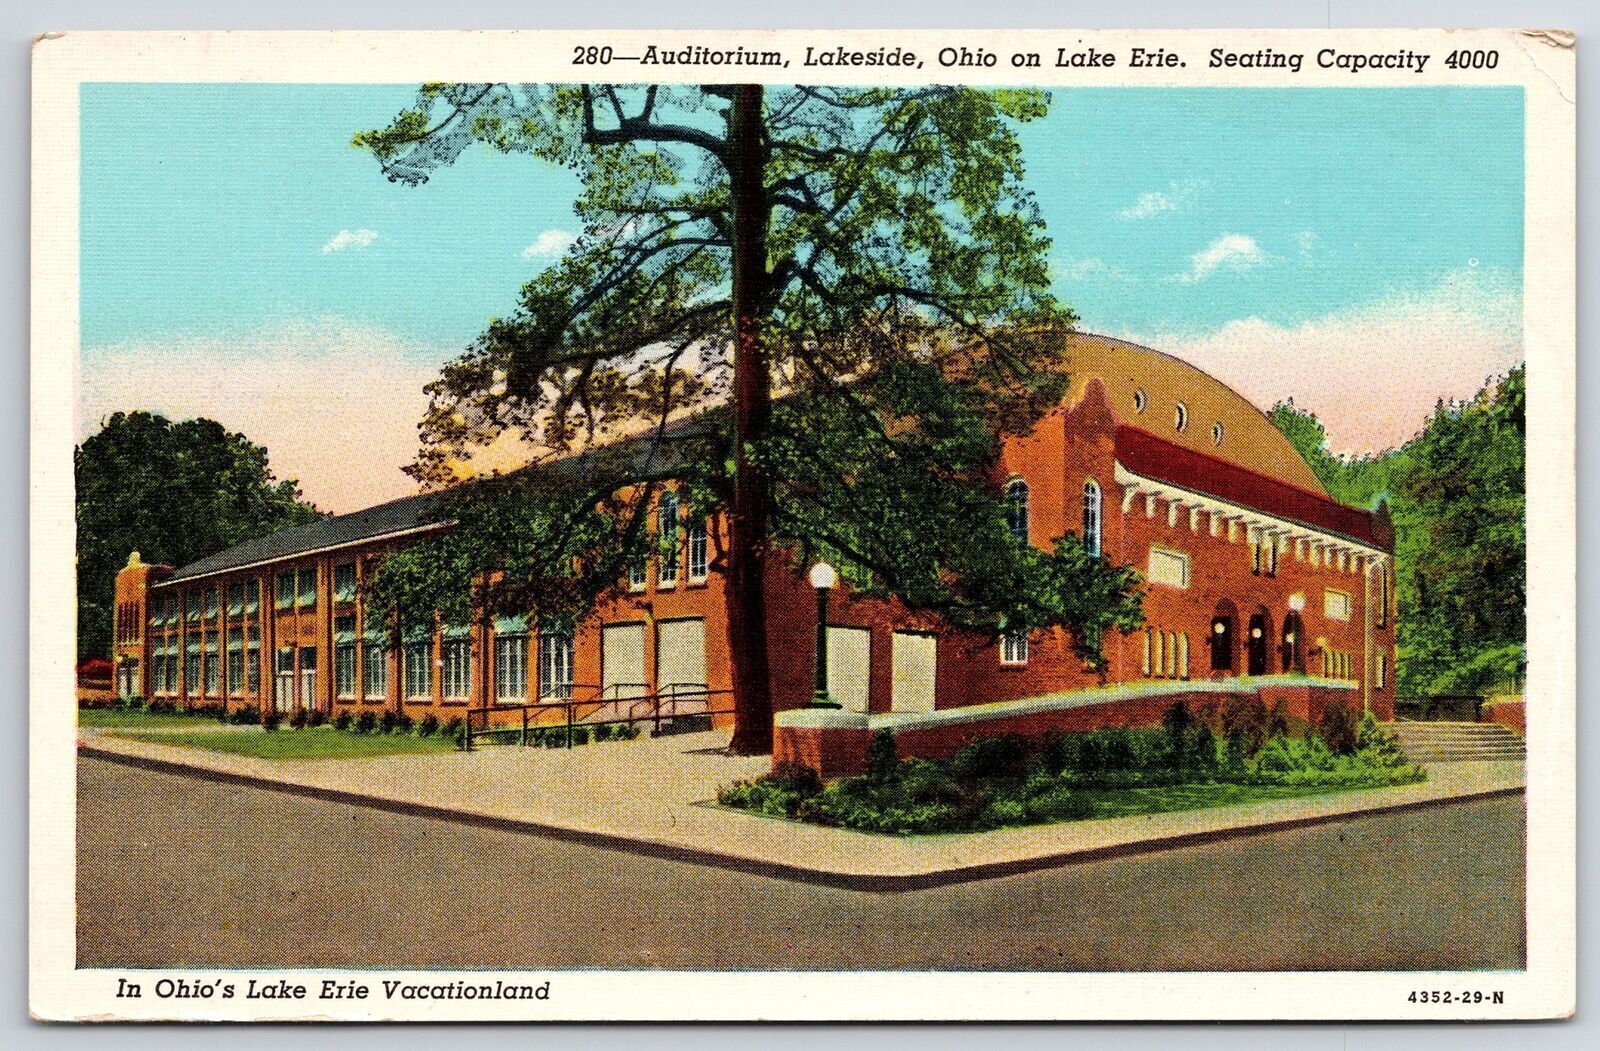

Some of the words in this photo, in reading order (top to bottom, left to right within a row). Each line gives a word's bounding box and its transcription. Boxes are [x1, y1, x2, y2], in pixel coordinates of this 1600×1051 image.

[803, 46, 924, 70] Lakeside,
[938, 47, 997, 68] Ohio
[1011, 53, 1041, 68] on
[1054, 48, 1116, 68] Lake
[1128, 48, 1187, 68] Erie.
[1208, 48, 1304, 73] Seating
[1316, 48, 1431, 74] Capacity
[1444, 49, 1499, 70] 4000
[116, 978, 142, 998] In
[155, 978, 235, 999] Ohio's
[246, 979, 307, 1000] Lake
[318, 980, 370, 1000] Erie
[382, 980, 551, 1000] Vacationland
[1407, 990, 1504, 1004] 4352-29-N
